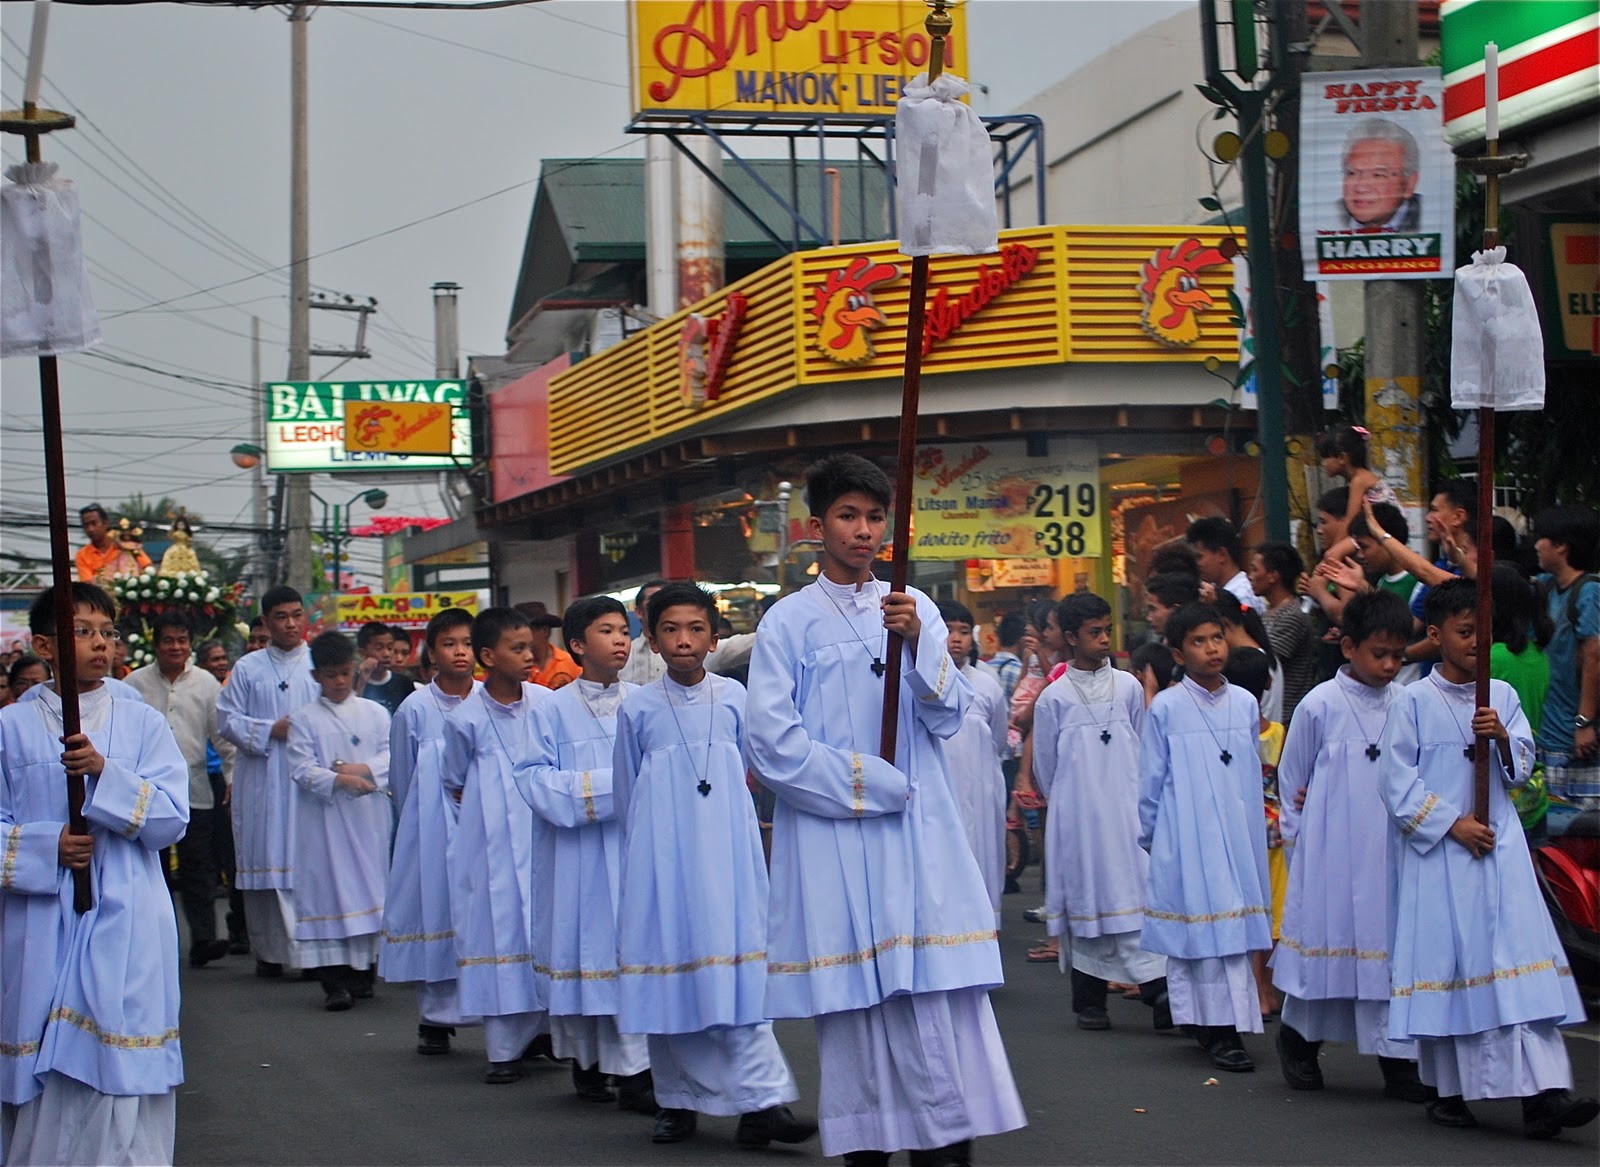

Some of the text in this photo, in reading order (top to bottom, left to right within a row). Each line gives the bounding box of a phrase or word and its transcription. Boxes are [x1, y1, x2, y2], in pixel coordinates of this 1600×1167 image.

[736, 70, 908, 107] MANOK LIE
[1324, 80, 1422, 99] HAPPY
[1335, 95, 1436, 113] FIESTA
[1322, 237, 1435, 258] HARRY
[361, 593, 451, 613] Angel's
